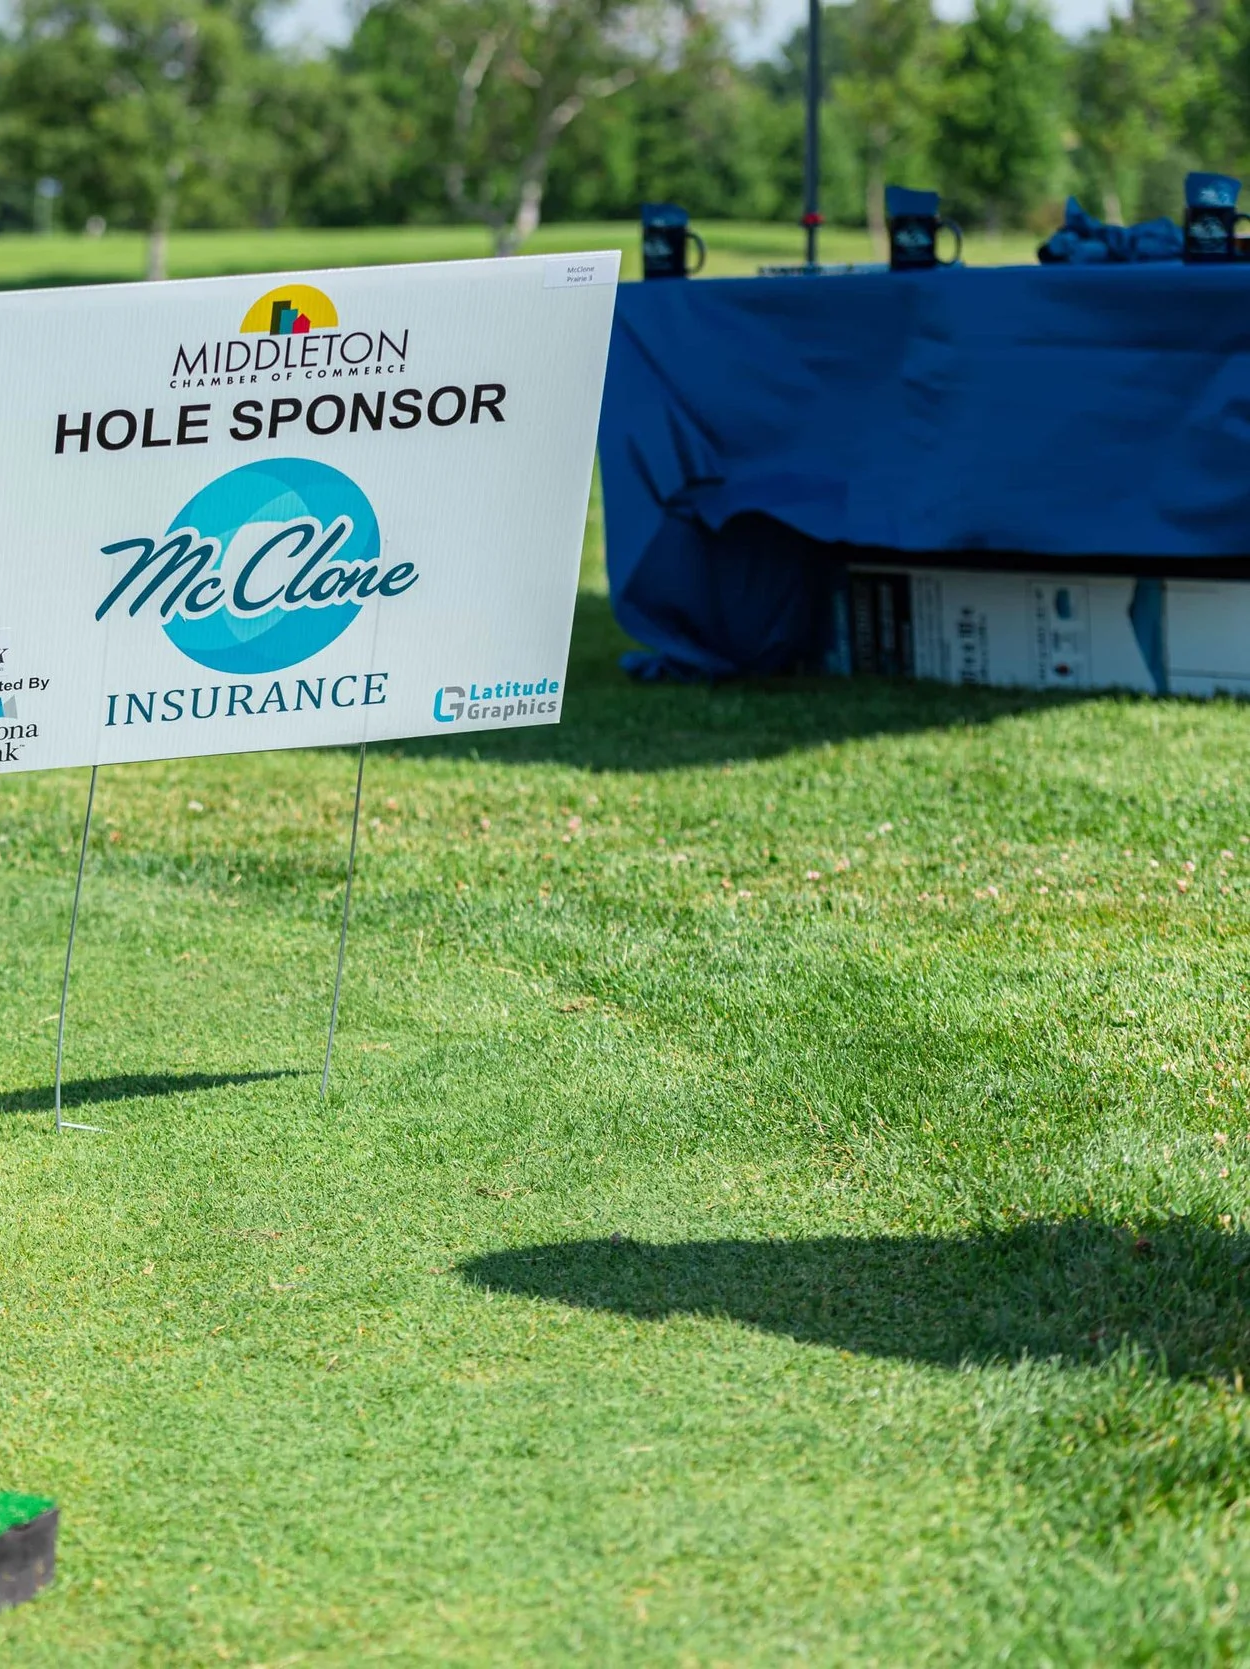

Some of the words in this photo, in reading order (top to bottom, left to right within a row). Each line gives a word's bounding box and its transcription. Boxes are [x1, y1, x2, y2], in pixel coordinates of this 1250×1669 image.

[567, 265, 595, 273] McClone
[172, 329, 409, 377] MIDDLETON
[169, 374, 258, 389] CHAMBER
[271, 371, 294, 382] OF
[305, 363, 406, 380] COMMERCE
[54, 403, 212, 455] HOLE
[228, 383, 508, 442] SPONSOR
[28, 677, 50, 691] By
[469, 677, 560, 701] Latitude
[104, 672, 389, 727] INSURANCE
[467, 699, 557, 721] Graphics
